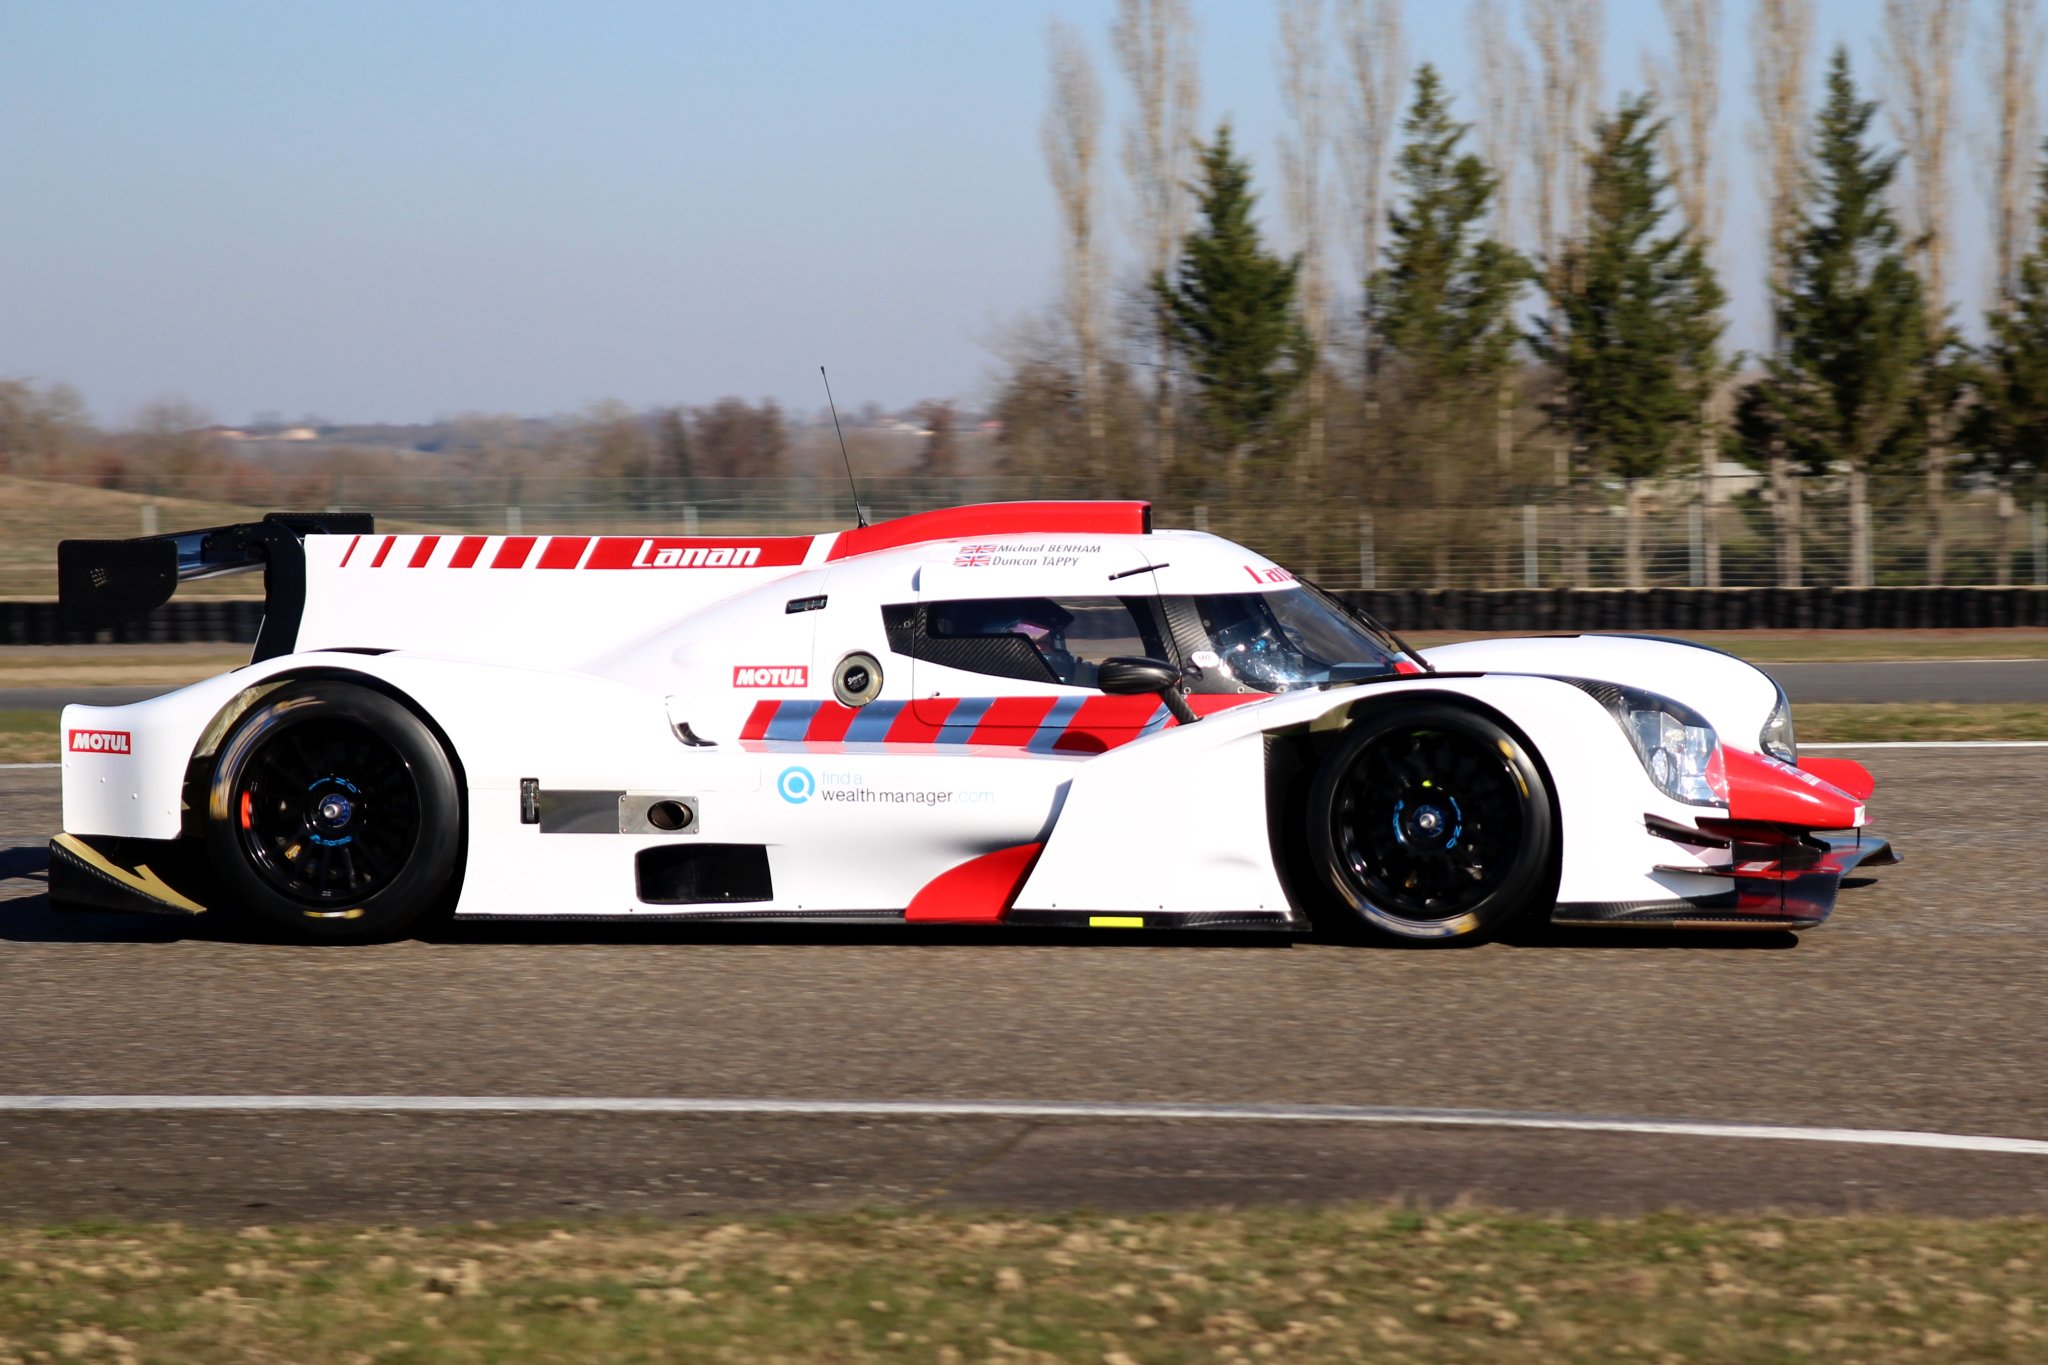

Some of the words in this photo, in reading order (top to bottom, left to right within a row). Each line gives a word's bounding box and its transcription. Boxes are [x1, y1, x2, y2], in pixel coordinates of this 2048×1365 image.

[631, 539, 762, 567] Lanan
[997, 544, 1045, 553] Michael
[1048, 545, 1101, 553] BENHAM
[992, 556, 1037, 566] Duncan
[1042, 556, 1080, 567] TAPPY
[735, 668, 805, 686] MOTUL
[72, 732, 129, 751] MOTUL
[821, 770, 851, 785] find
